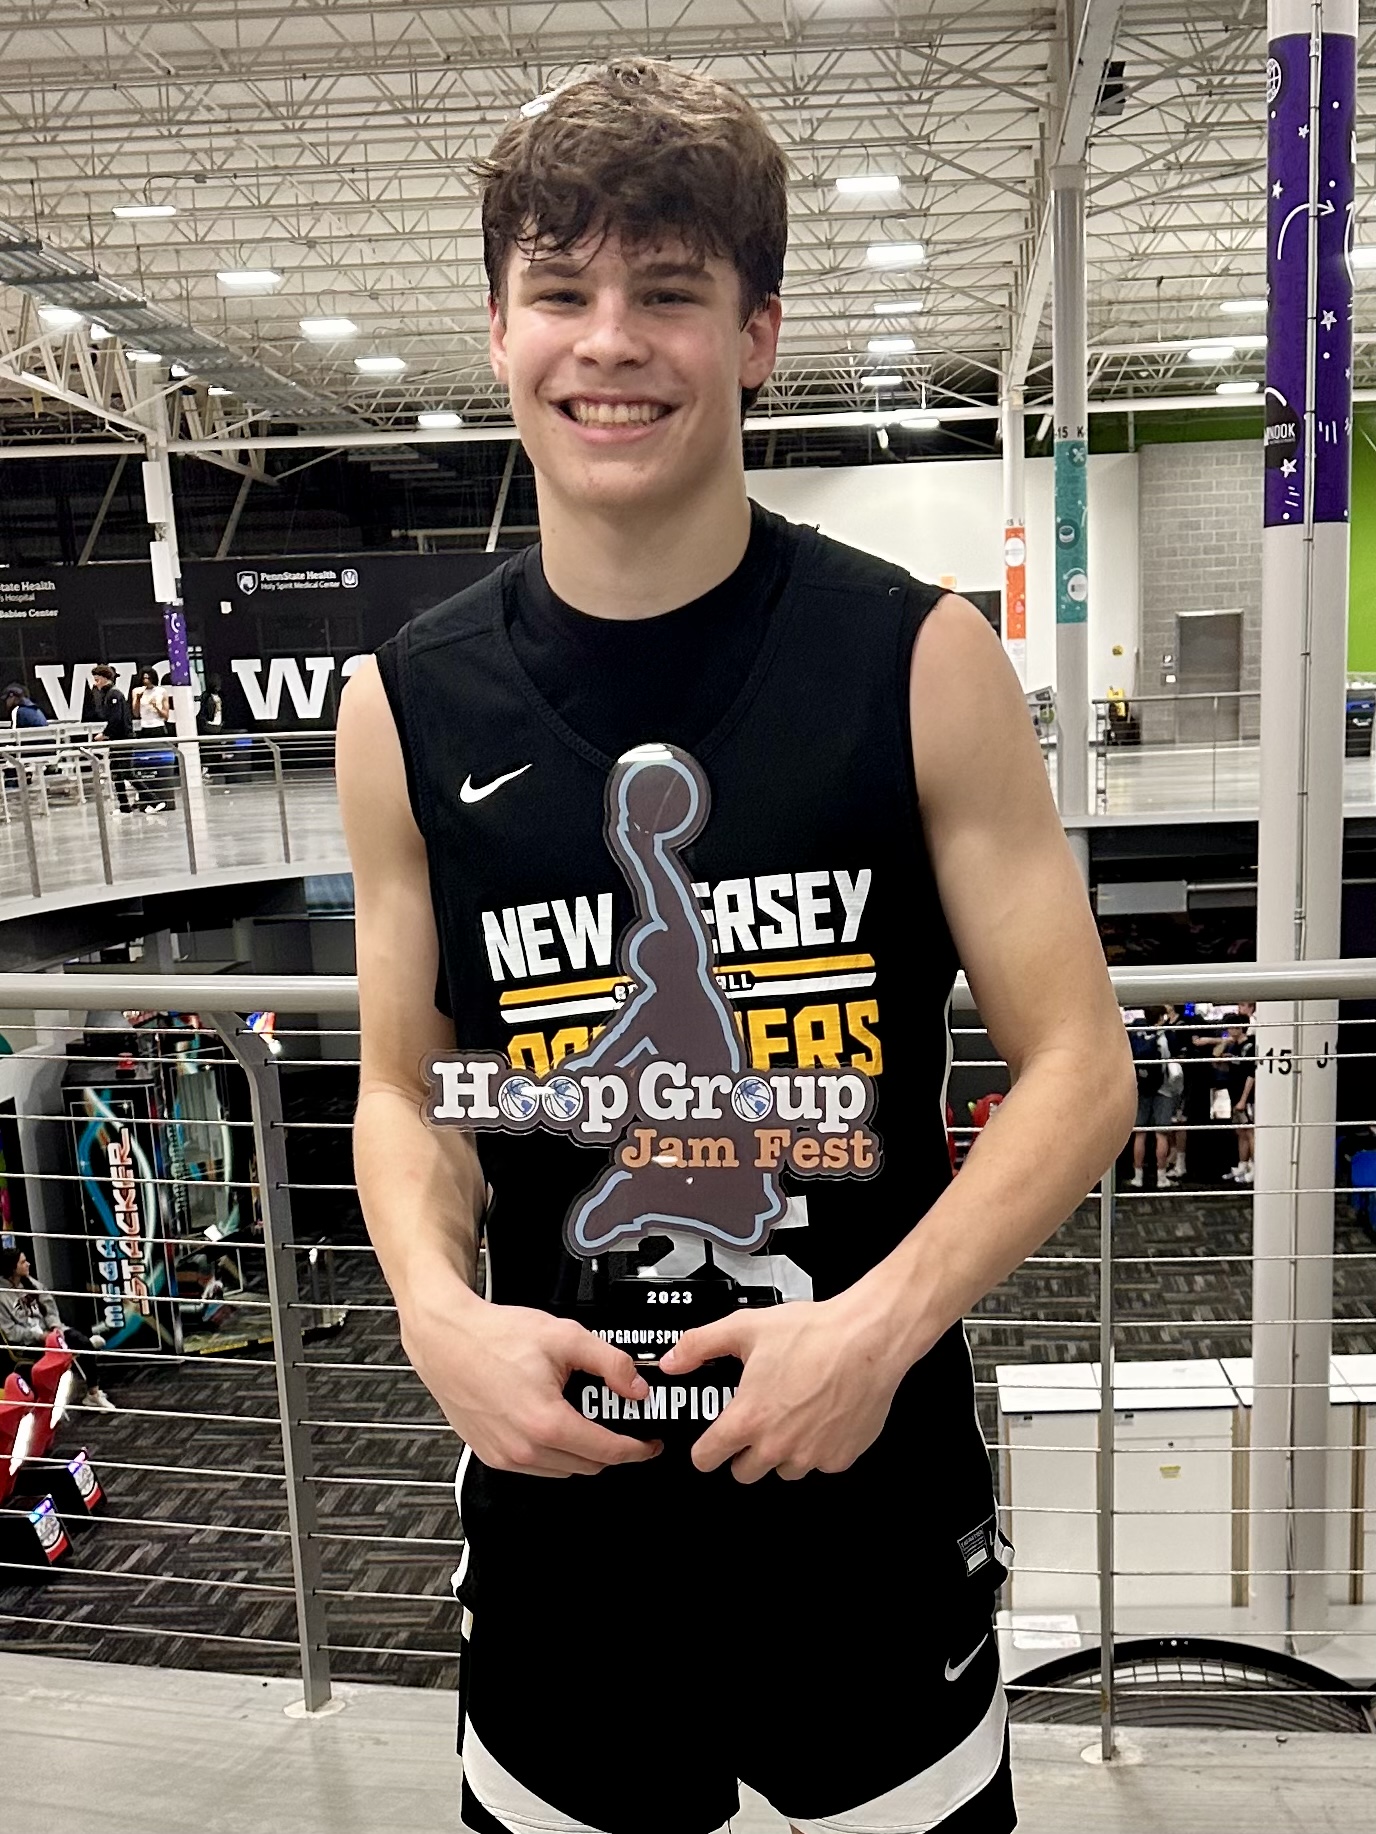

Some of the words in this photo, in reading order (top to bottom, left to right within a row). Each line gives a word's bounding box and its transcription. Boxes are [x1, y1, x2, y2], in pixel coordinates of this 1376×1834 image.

[260, 572, 306, 581] PennState
[306, 570, 337, 580] Health
[21, 580, 56, 592] Health
[28, 608, 59, 618] Center
[481, 892, 613, 982] NEW
[691, 868, 872, 955] RSEY
[432, 1061, 629, 1134] Hoop
[637, 1061, 867, 1134] Group
[621, 1128, 739, 1169] Jam
[754, 1128, 874, 1169] Fest
[107, 1127, 150, 1316] STACKER
[646, 1290, 693, 1305] 2023
[615, 1329, 655, 1344] GROUP
